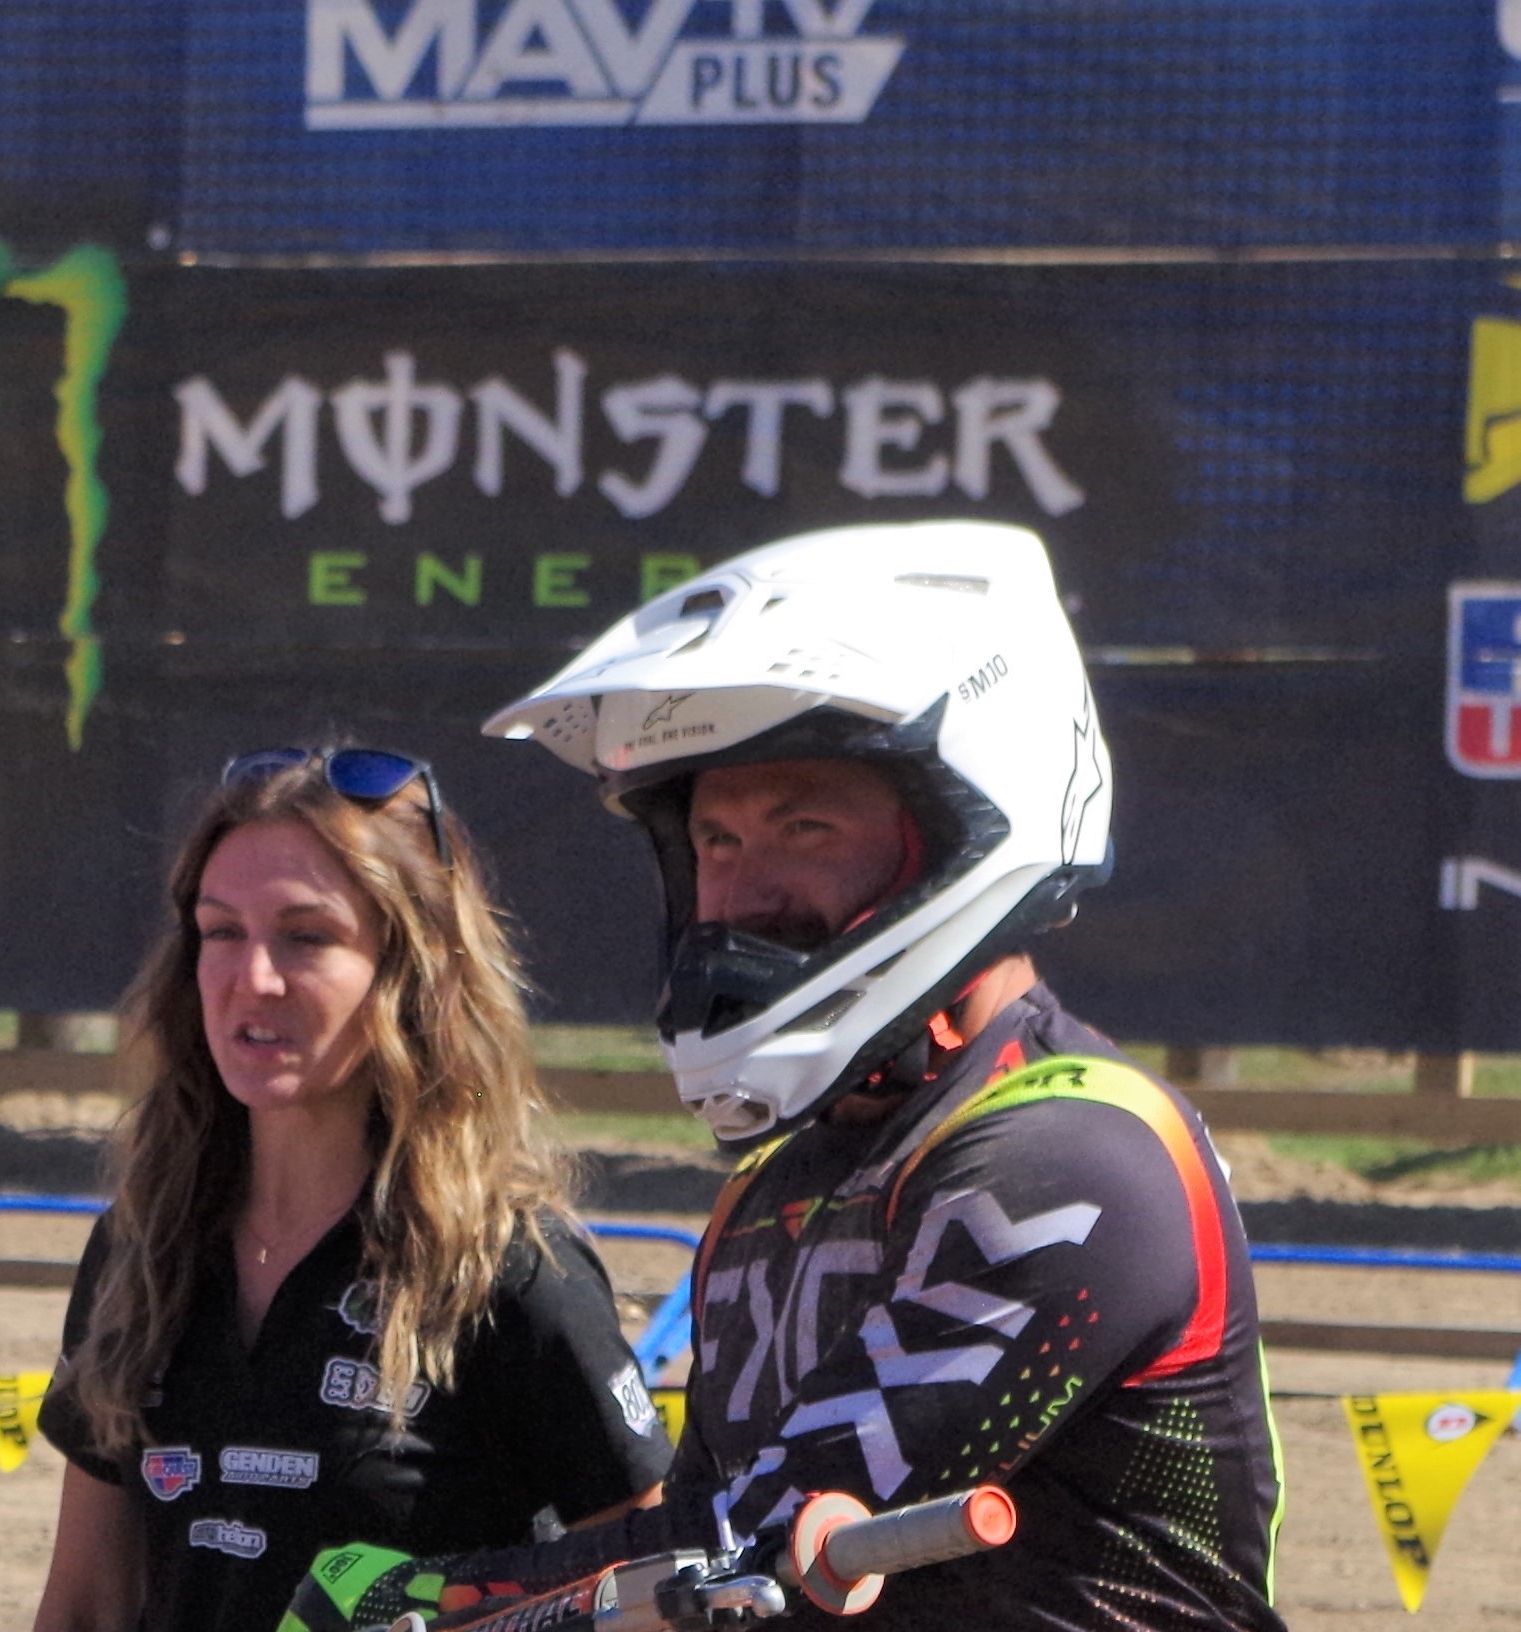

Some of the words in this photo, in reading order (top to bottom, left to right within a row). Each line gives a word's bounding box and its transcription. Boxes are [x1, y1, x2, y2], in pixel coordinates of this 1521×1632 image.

[689, 54, 842, 111] PLUS
[173, 350, 1085, 523] MONSTER
[225, 1452, 315, 1476] GENDEN
[1349, 1395, 1429, 1570] DUNLOP
